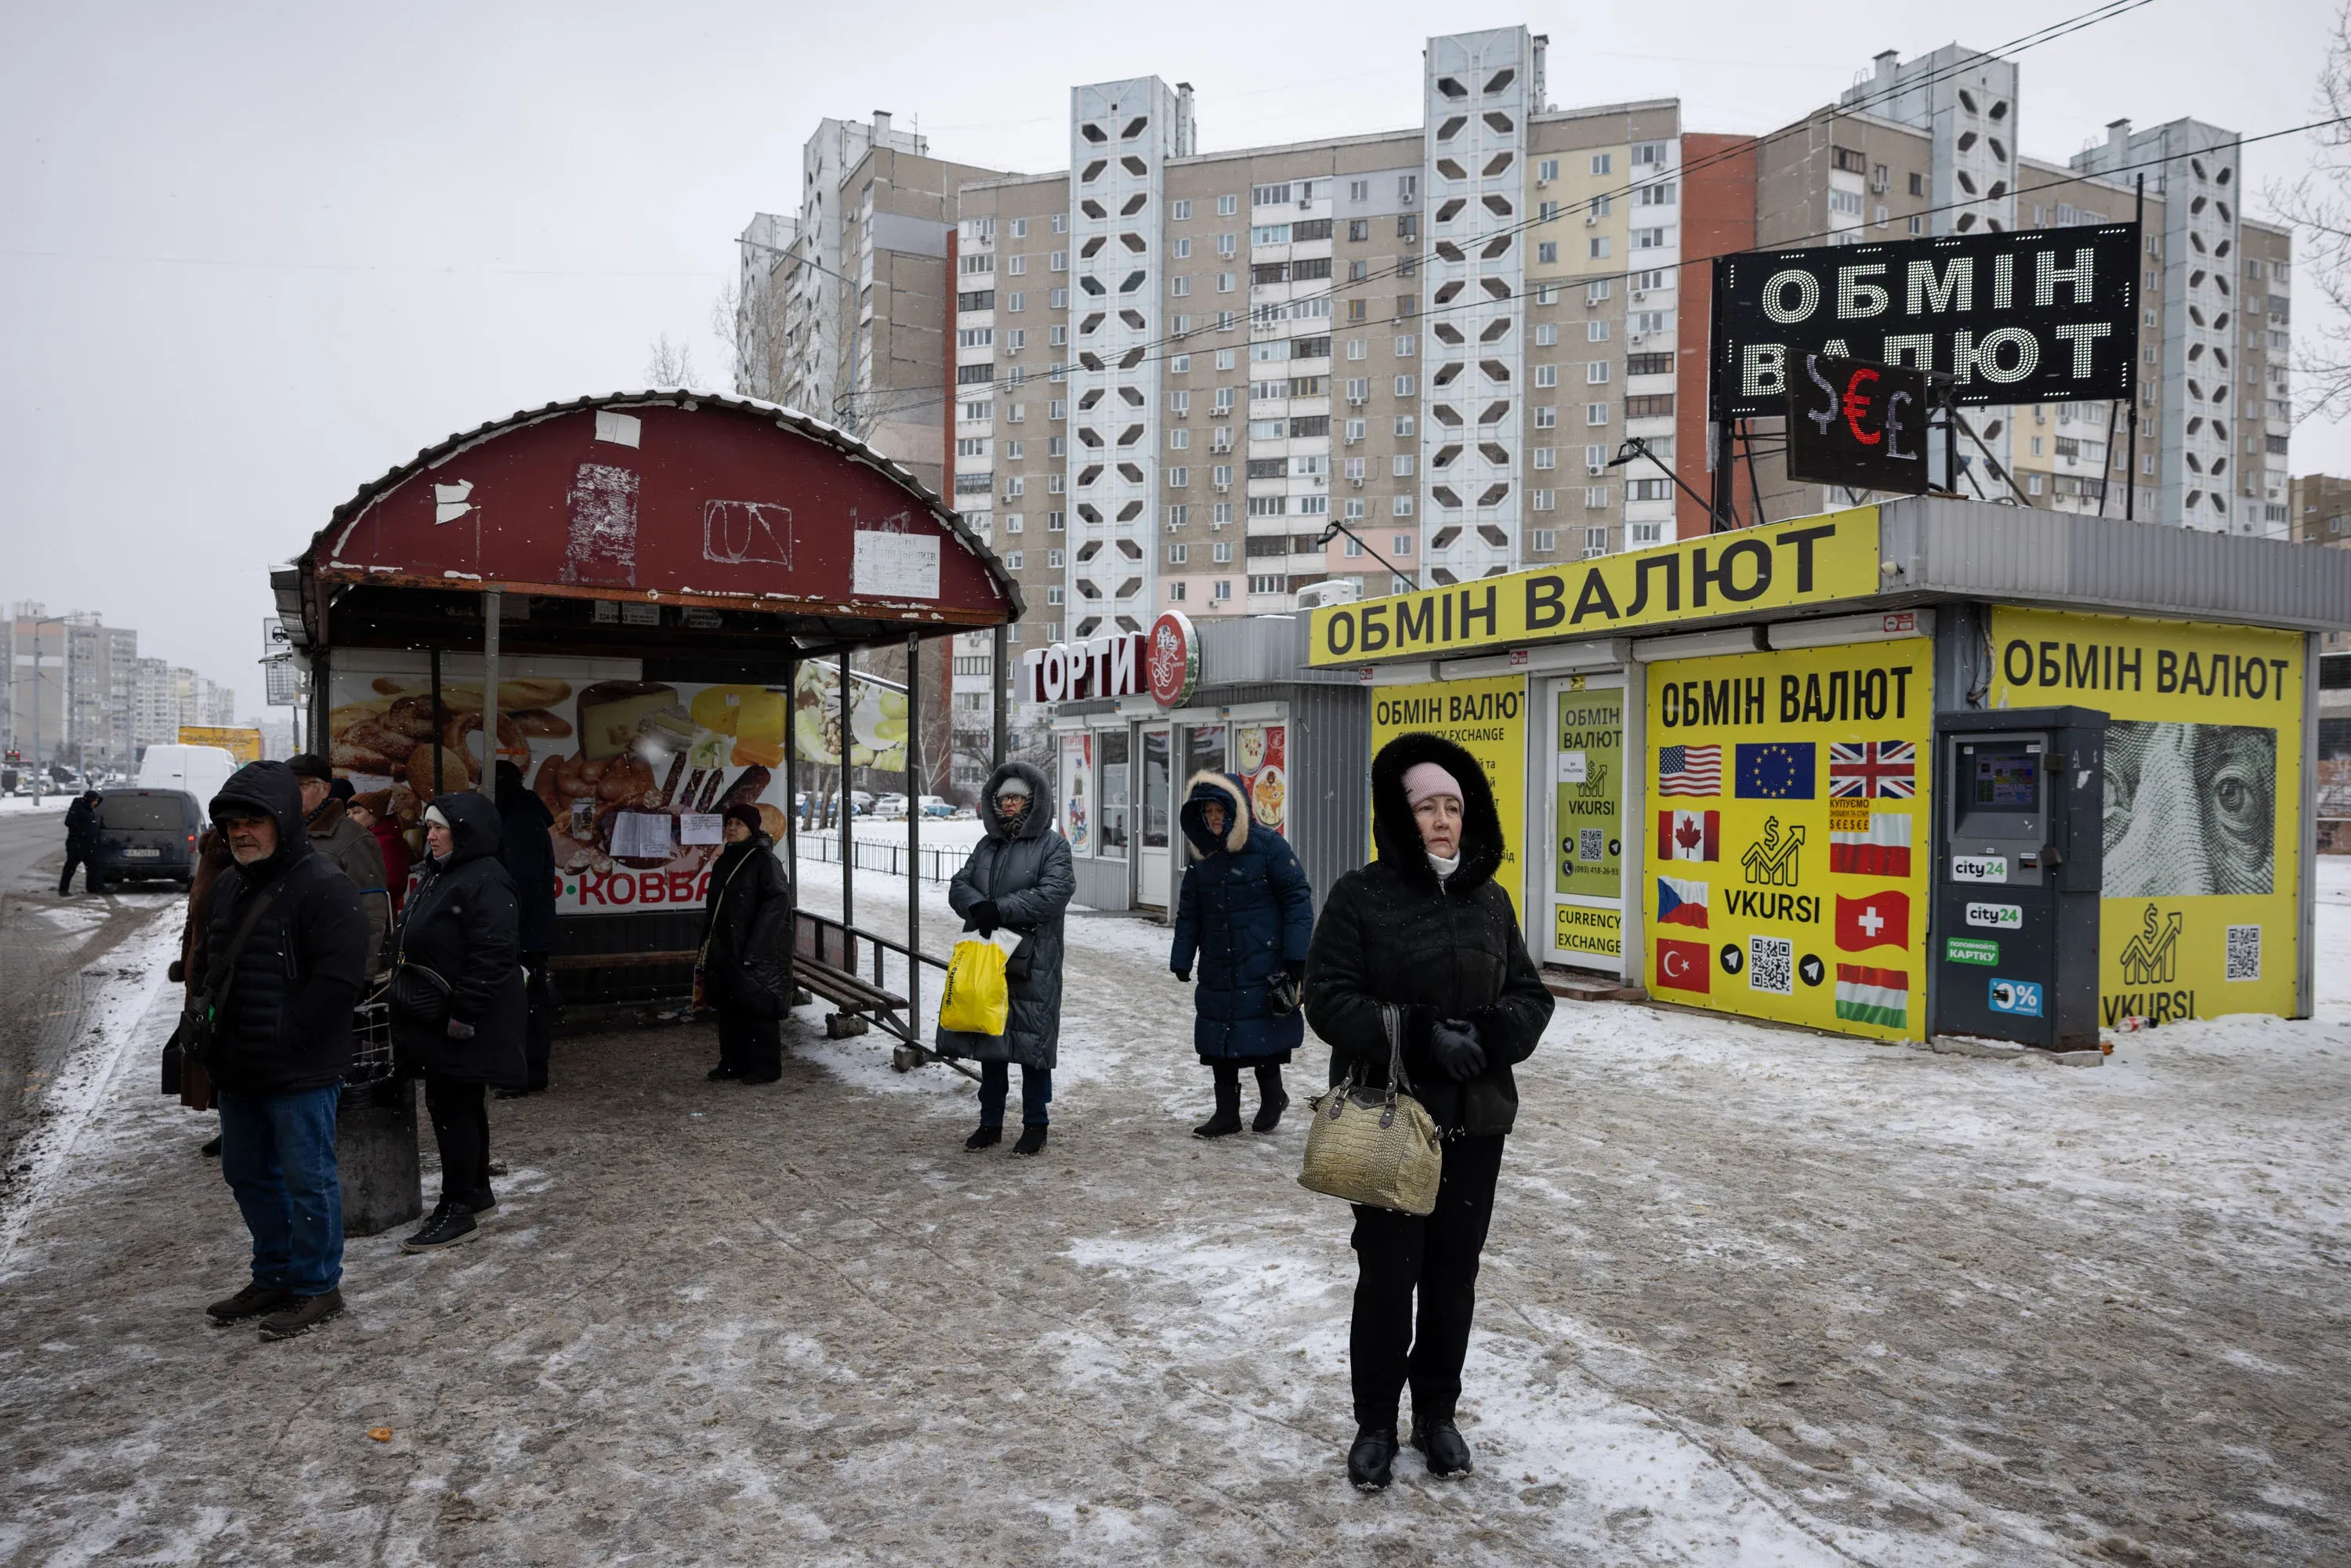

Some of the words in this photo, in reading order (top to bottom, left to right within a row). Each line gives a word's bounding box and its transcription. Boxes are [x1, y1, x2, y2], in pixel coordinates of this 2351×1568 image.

[1762, 248, 2095, 324] ОБМІН
[1742, 322, 2111, 397] ВЛЮТ
[1327, 585, 1498, 657] ОБМІН
[1525, 523, 1836, 630] ВАЛЮТ
[1023, 636, 1136, 704] ТОРТИ
[2004, 639, 2143, 692] ОБМІН
[2157, 649, 2289, 701] ВАЛЮТ
[1661, 676, 1765, 728] ОБМІН
[1780, 666, 1913, 723] ВАЛЮТ
[1377, 697, 1443, 726] ОБМІН
[1565, 707, 1620, 726] ОБМІН
[1449, 727, 1505, 741] EXCHANGE
[1563, 730, 1622, 749] ВАЛЮТ
[1569, 800, 1614, 816] VKURSI
[1830, 798, 1869, 808] КУПУЄМО
[1574, 865, 1589, 874] (093)
[1590, 866, 1619, 875] 418-26-93
[1955, 860, 2005, 878] city24
[1724, 888, 1820, 925] VKURSI
[1969, 906, 2019, 924] city24
[1559, 910, 1621, 929] CURRENCY
[1557, 932, 1621, 954] EXCHANGE
[1949, 949, 1996, 961] КАРТКУ
[1996, 983, 2038, 1009] 0%
[2102, 989, 2195, 1027] VKURSI
